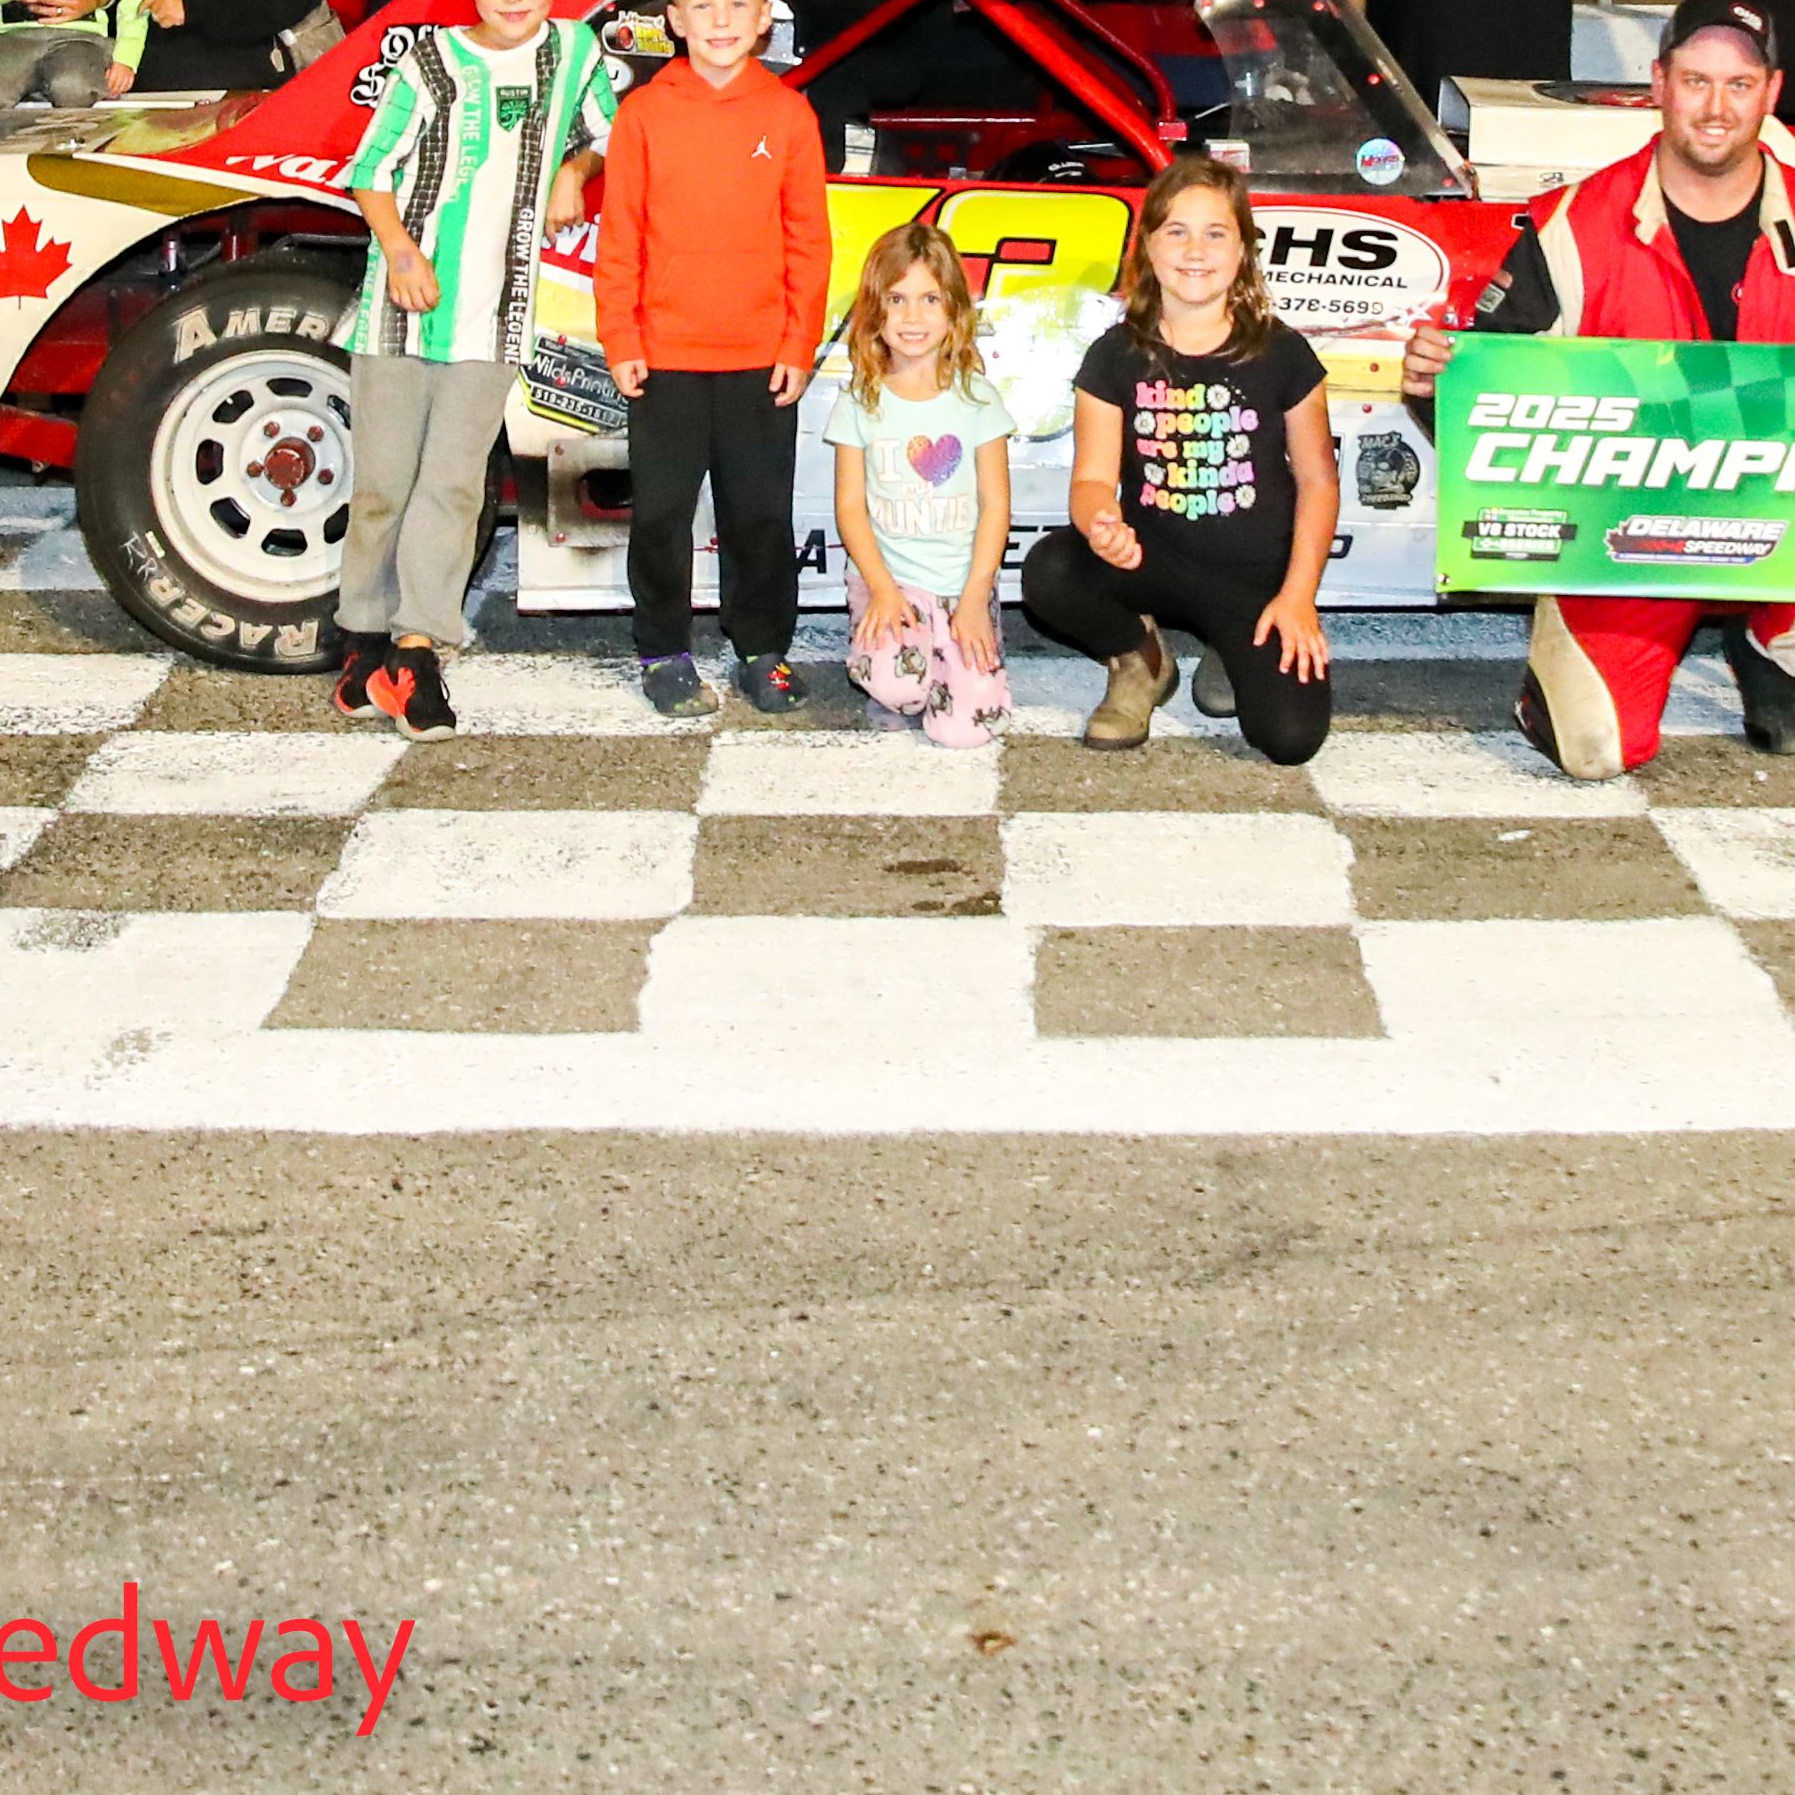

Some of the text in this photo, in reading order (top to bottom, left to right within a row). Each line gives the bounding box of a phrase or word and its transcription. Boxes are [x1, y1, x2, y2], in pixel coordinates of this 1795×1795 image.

[515, 208, 535, 263] GROW
[1255, 225, 1399, 270] HS
[511, 264, 530, 299] THE
[1261, 271, 1408, 289] MECHANICAL
[1135, 380, 1206, 410] kind
[1155, 405, 1259, 439] people
[1467, 393, 1640, 432] 2025
[874, 439, 902, 482] I
[1182, 440, 1225, 465] my
[1167, 459, 1255, 489] kinda
[871, 493, 969, 536] AUNTIE
[1139, 483, 1237, 521] people
[1478, 522, 1562, 538] V8 STOCK
[1626, 517, 1784, 541] DELAWARE
[1683, 540, 1772, 556] SPEEDWAY
[148, 574, 320, 658] RACER
